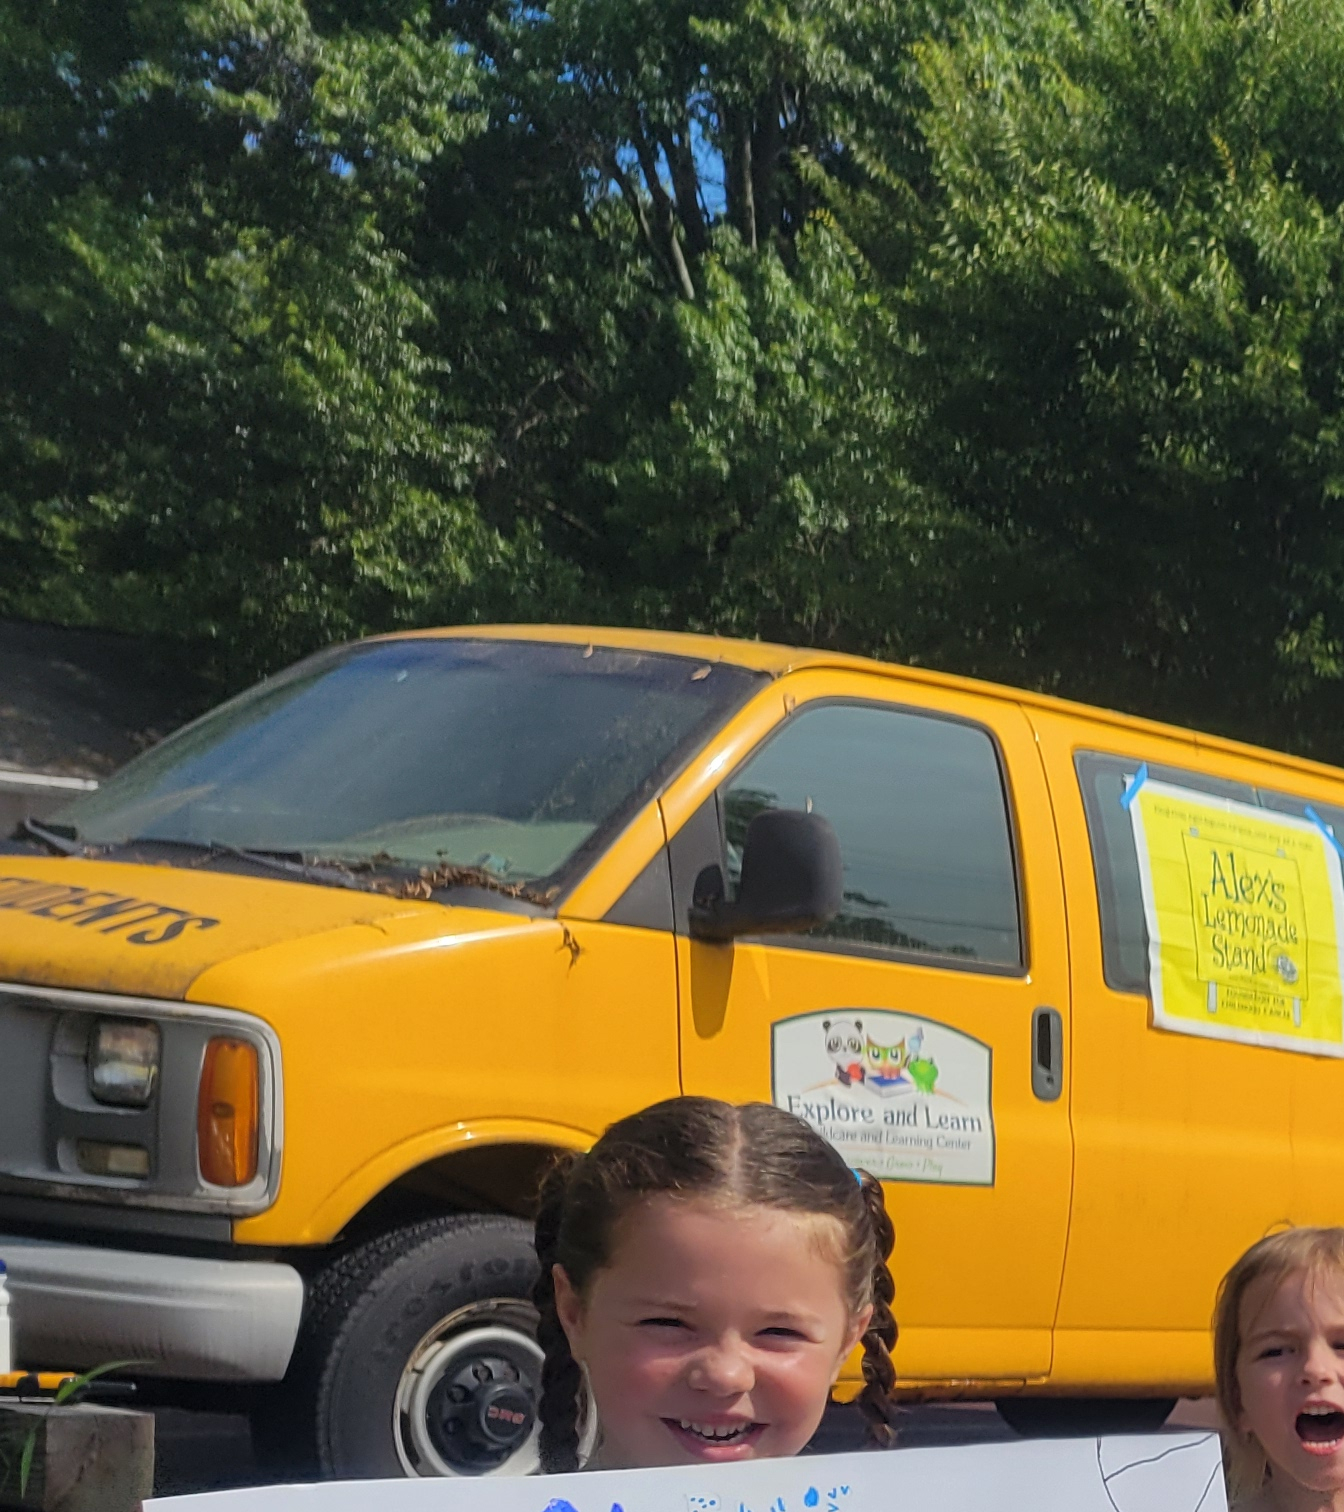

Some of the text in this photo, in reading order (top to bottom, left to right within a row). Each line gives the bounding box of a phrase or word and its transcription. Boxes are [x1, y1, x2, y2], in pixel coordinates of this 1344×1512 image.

[1202, 892, 1298, 945] Lemonade
[1212, 934, 1267, 975] Stand
[788, 1095, 982, 1133] Explore and Learn
[819, 1126, 972, 1152] ildcare and Learning Center
